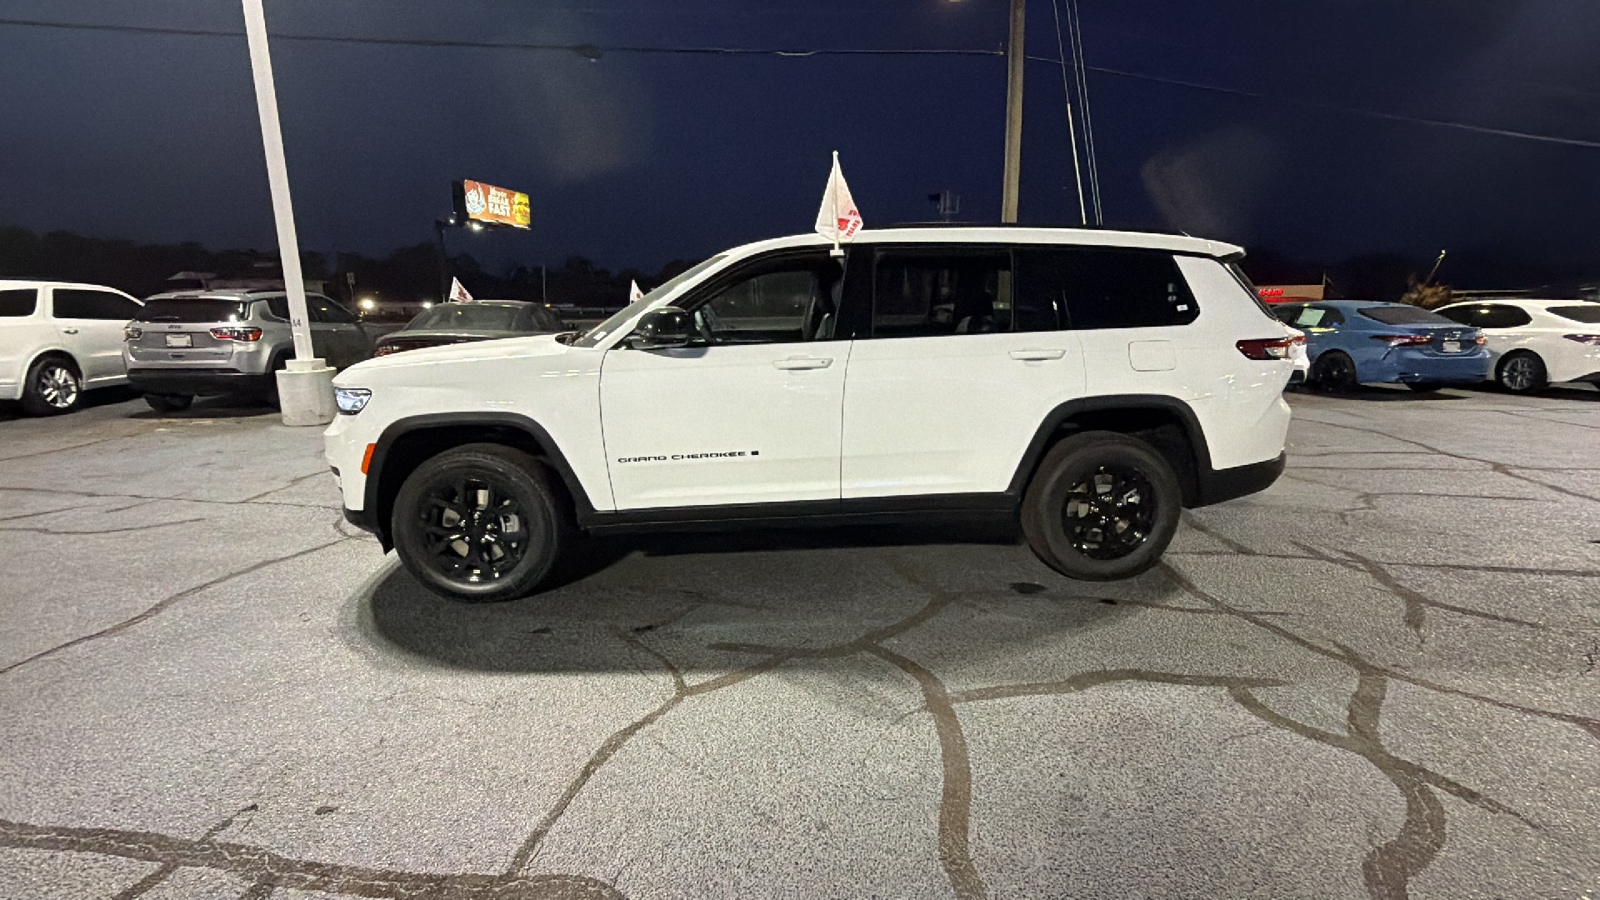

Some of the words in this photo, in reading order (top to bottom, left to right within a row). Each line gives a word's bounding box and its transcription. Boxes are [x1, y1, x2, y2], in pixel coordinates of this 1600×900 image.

[488, 202, 511, 217] FAST
[617, 455, 667, 463] GRAND
[671, 451, 746, 460] CHEROKEE
